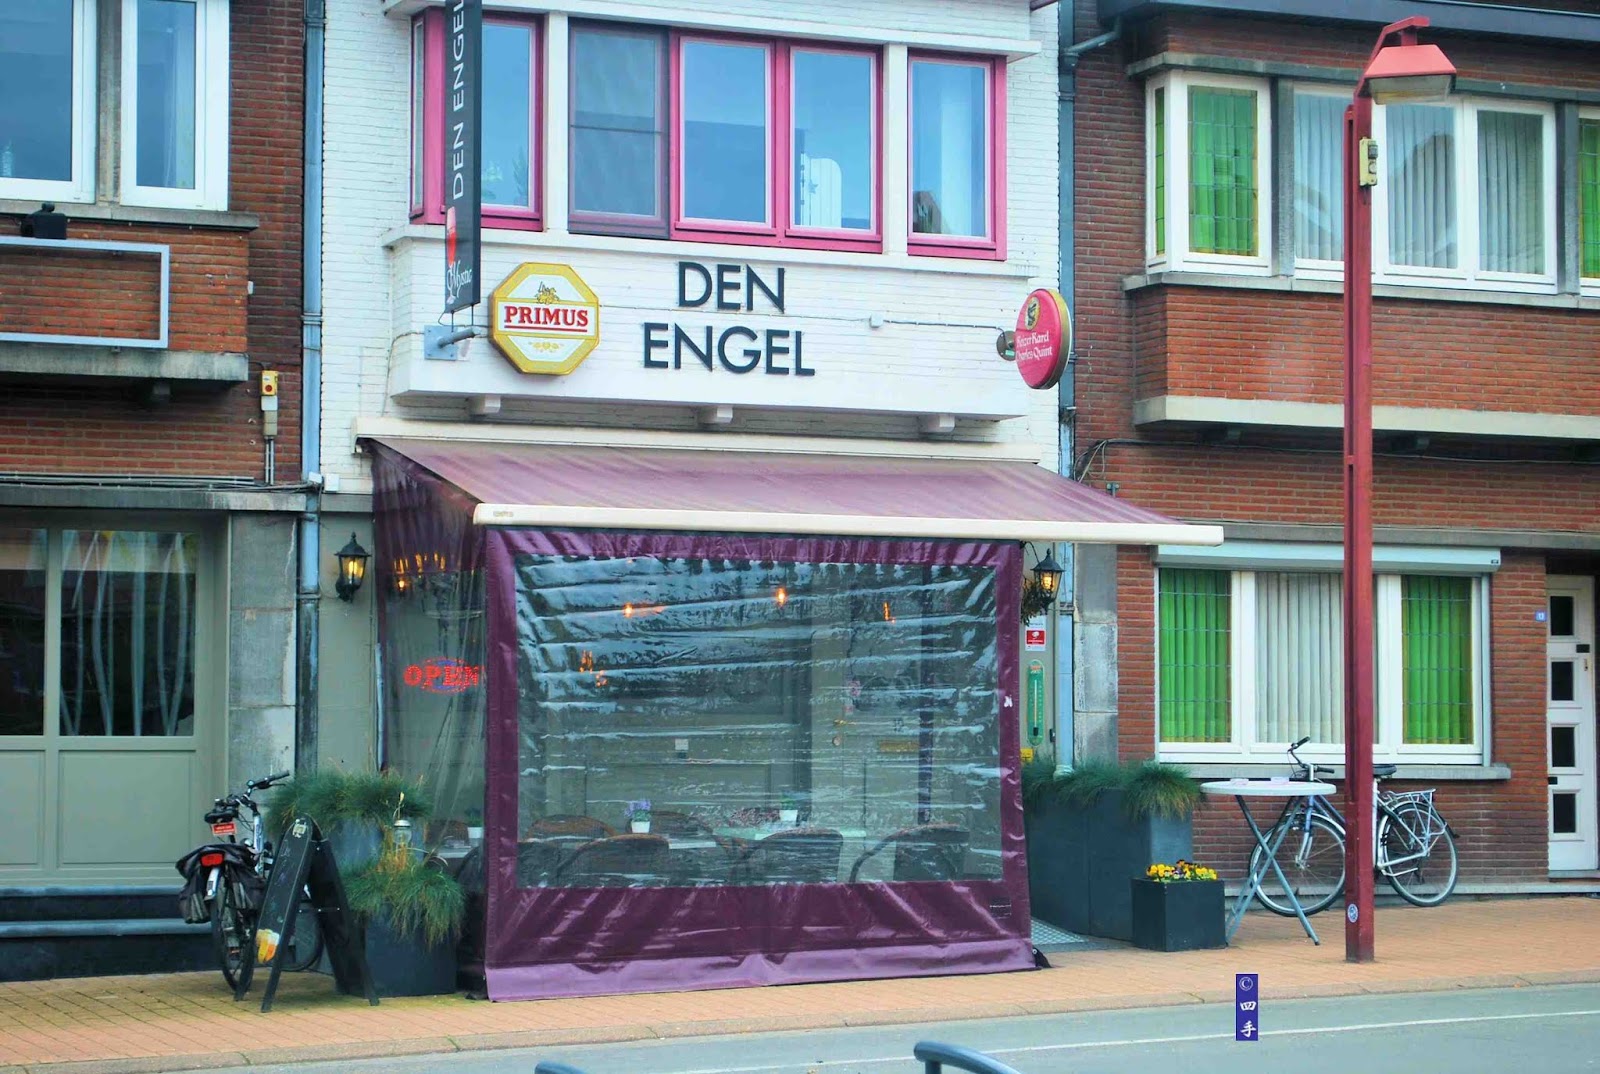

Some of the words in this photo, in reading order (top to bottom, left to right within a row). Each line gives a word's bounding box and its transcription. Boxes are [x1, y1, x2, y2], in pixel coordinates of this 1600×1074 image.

[453, 122, 464, 200] DEN
[678, 261, 785, 313] DEN
[504, 305, 588, 327] PRIMUS
[644, 322, 815, 376] ENGEL
[403, 664, 479, 686] OPEN
